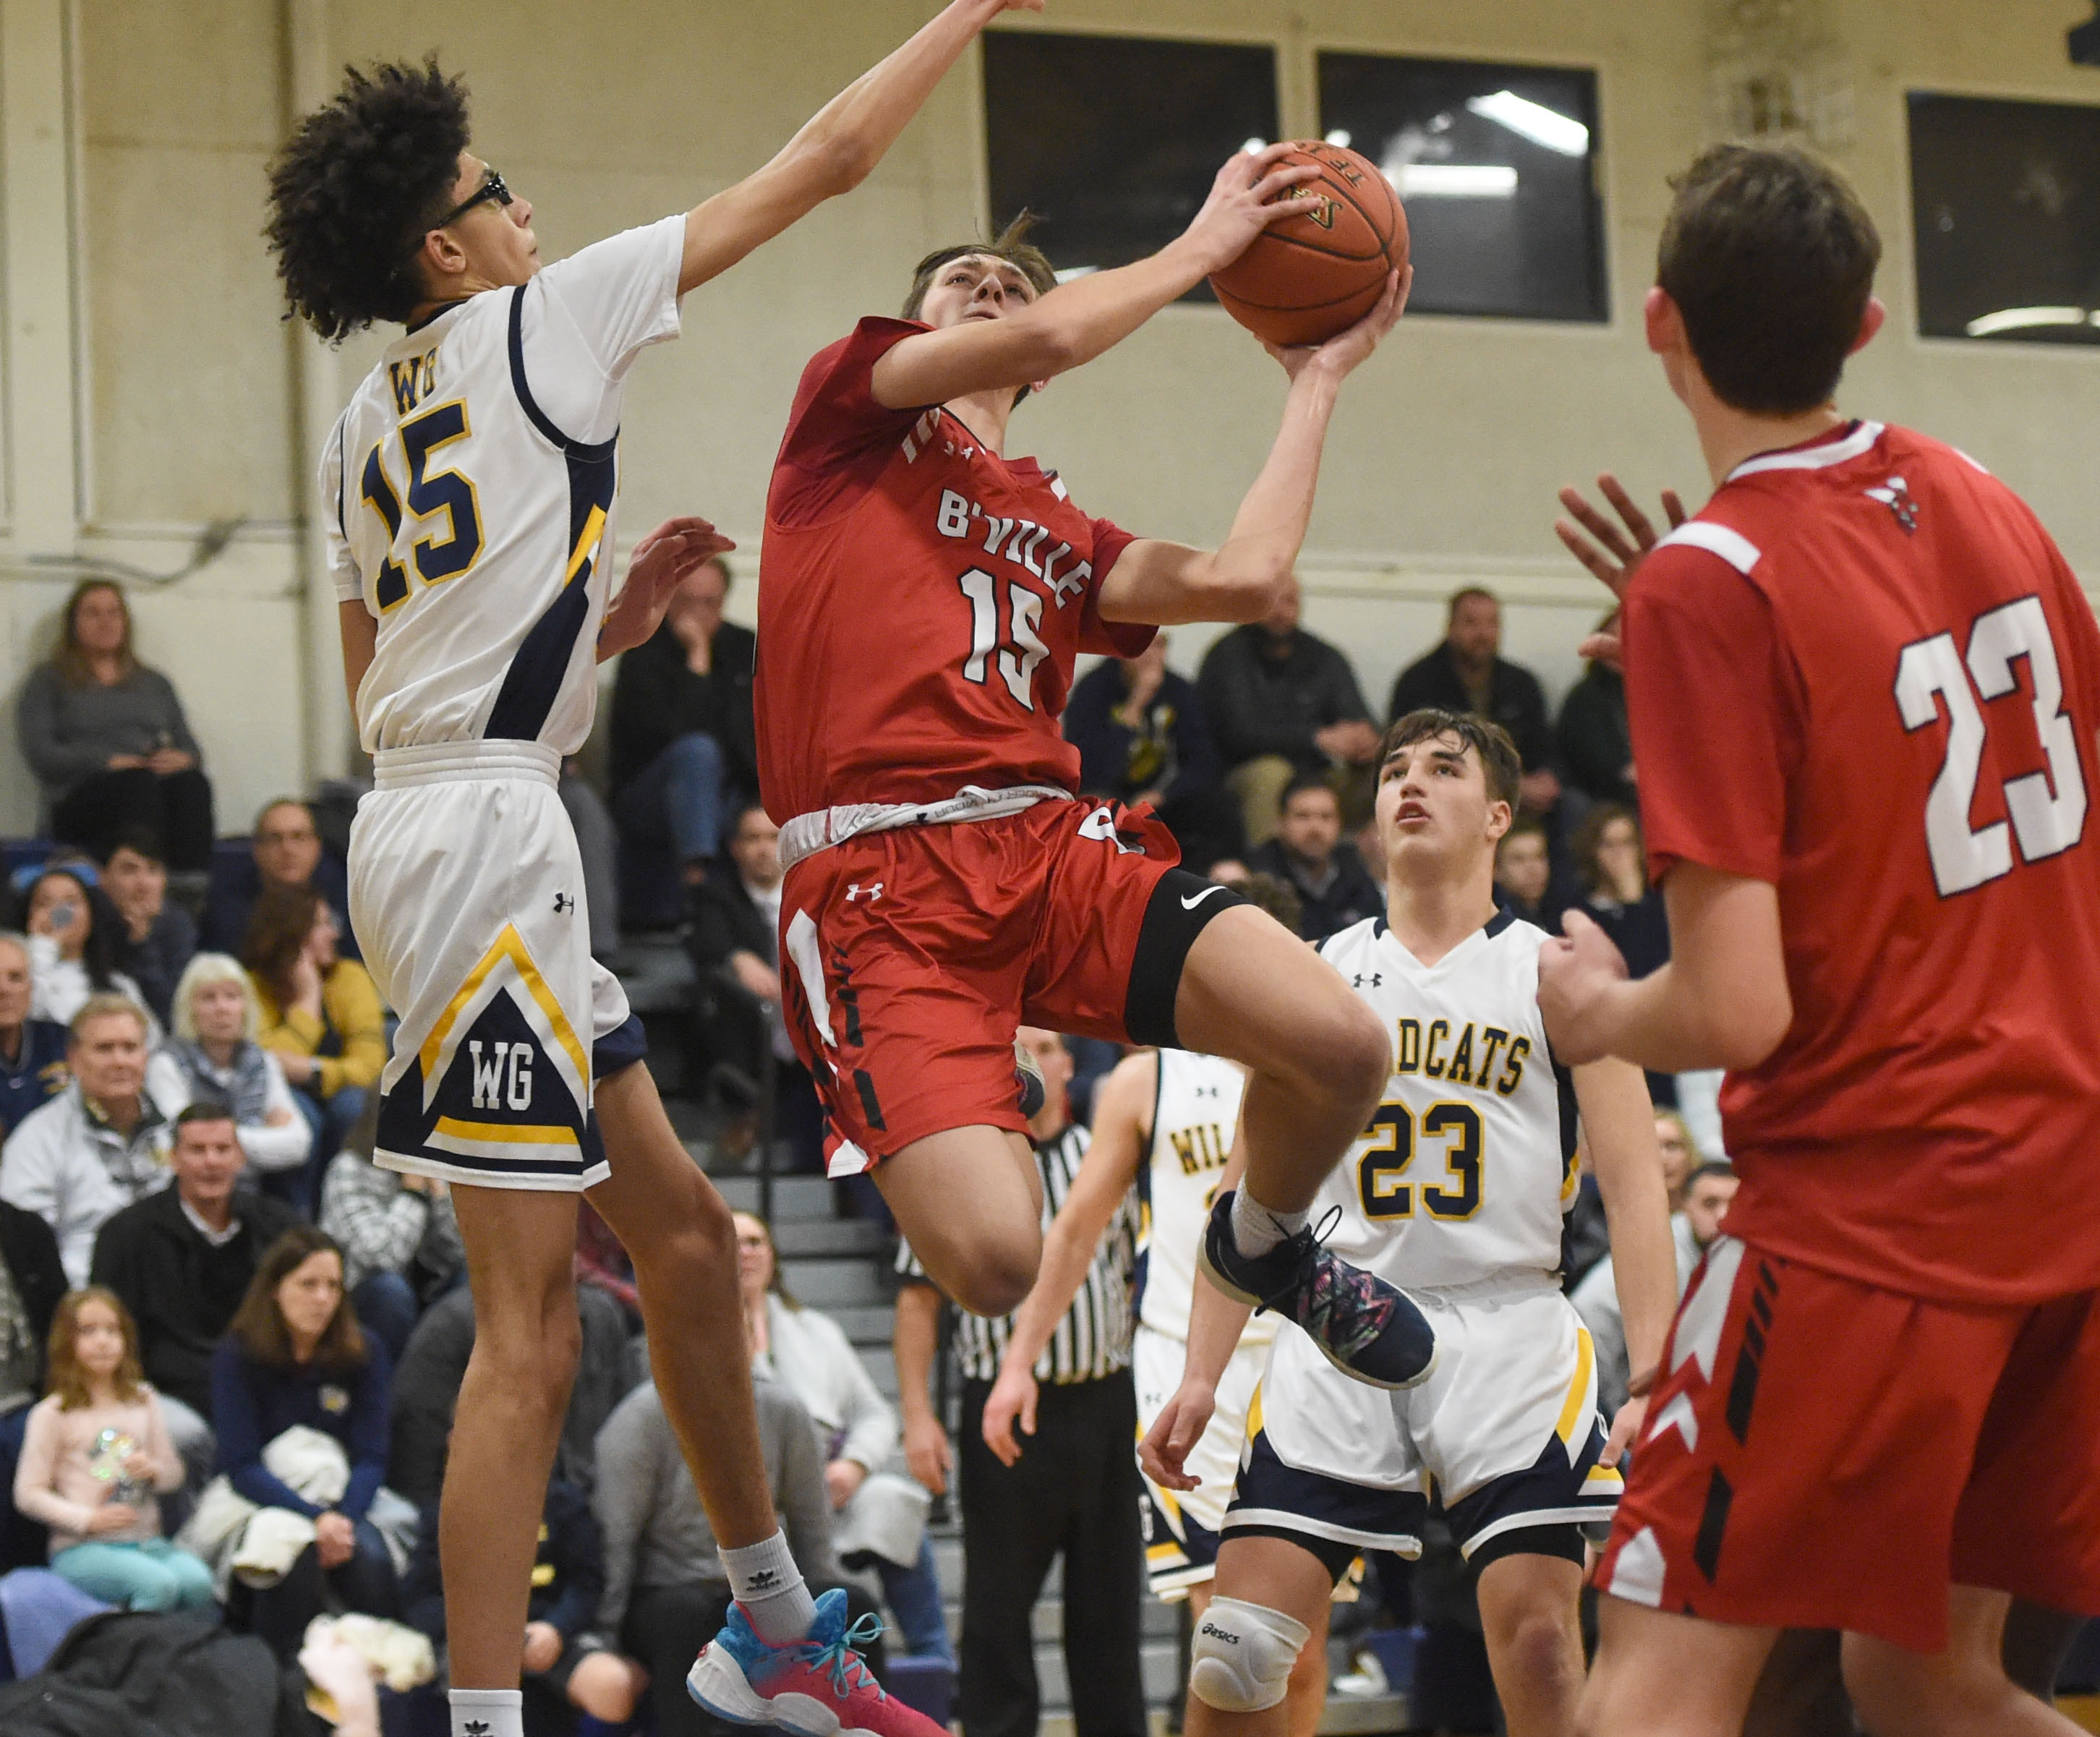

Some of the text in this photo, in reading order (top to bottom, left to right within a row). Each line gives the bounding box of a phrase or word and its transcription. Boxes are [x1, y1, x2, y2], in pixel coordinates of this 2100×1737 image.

[362, 397, 485, 615] 15
[936, 488, 1092, 610] B'VILLE
[957, 565, 1050, 712] 15
[1893, 594, 2088, 899] 23
[469, 1040, 534, 1111] WG
[1397, 1017, 1531, 1098] DCATS
[1169, 1122, 1229, 1176] WIL
[1357, 1099, 1485, 1221] 23
